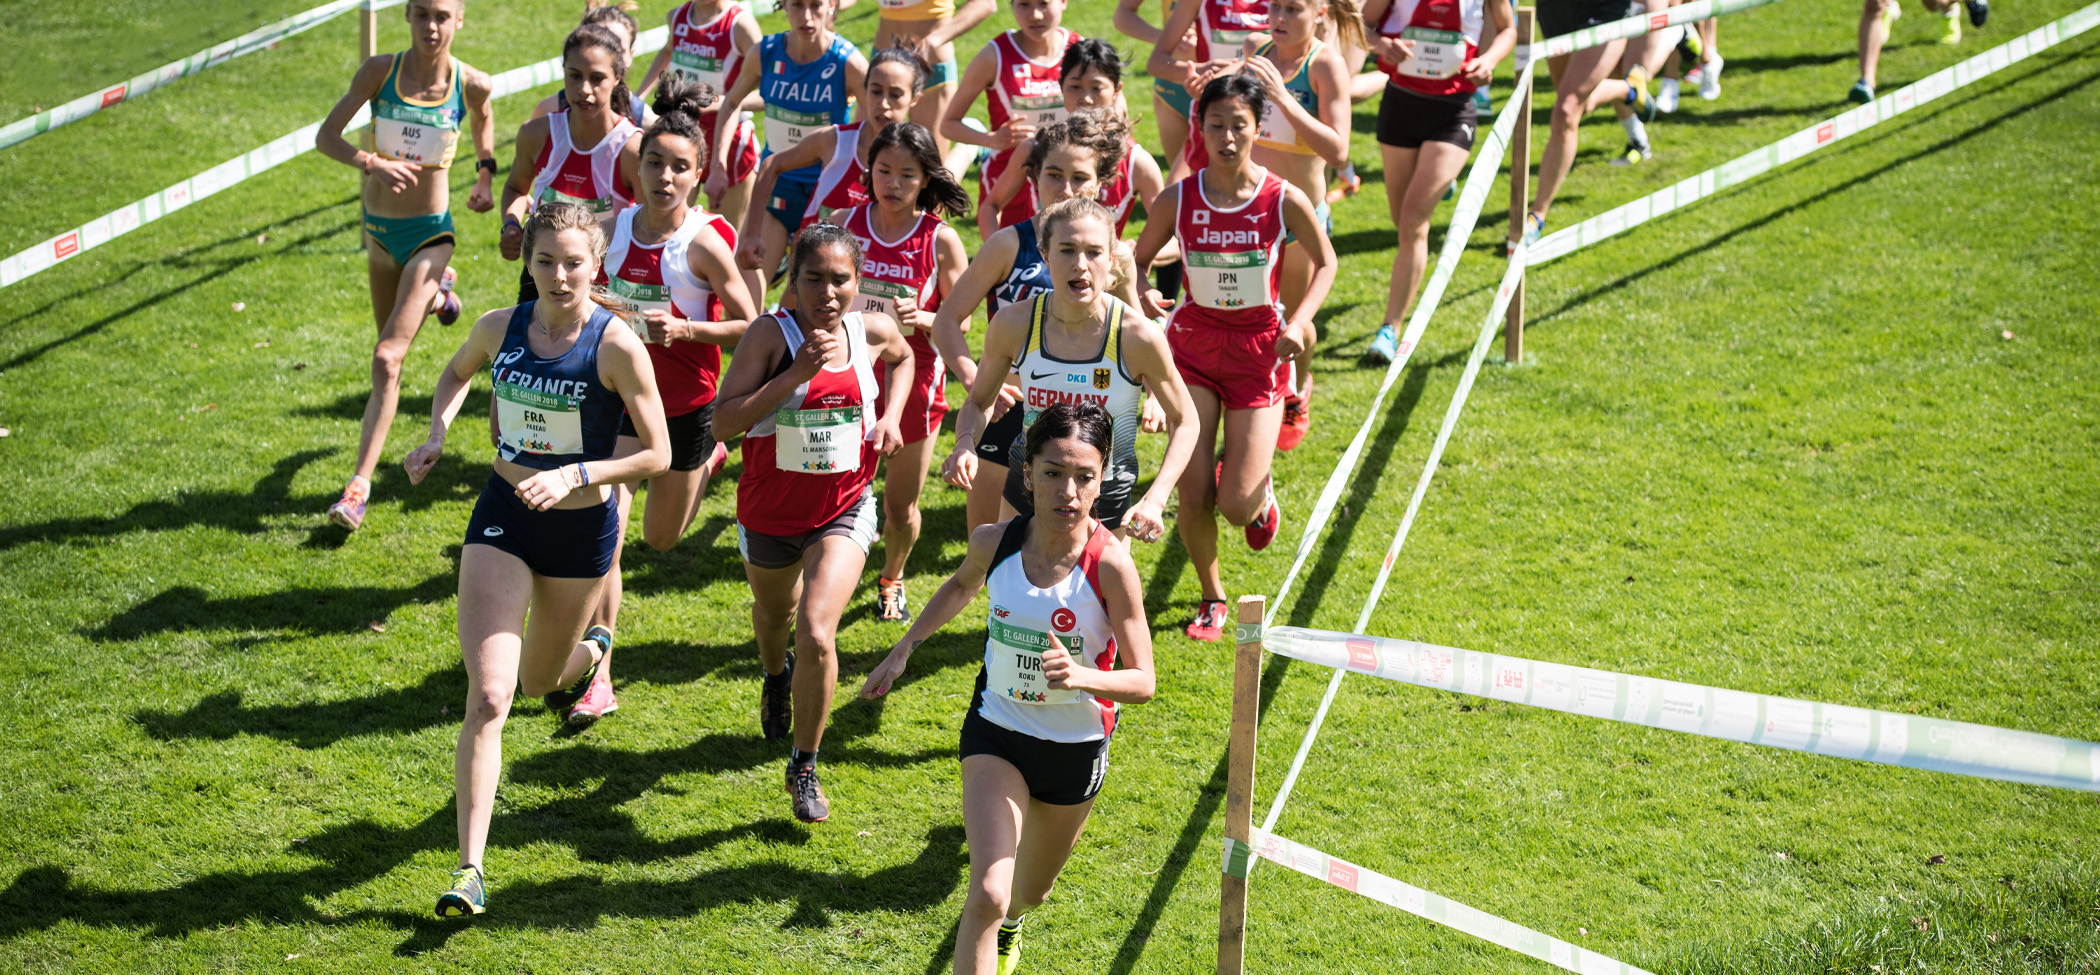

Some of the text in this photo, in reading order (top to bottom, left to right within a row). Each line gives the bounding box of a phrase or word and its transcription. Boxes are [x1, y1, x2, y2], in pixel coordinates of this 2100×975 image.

[770, 80, 832, 103] ITALIA
[1020, 79, 1062, 97] Japa
[402, 126, 421, 139] AUS
[788, 127, 802, 138] ITA
[1196, 227, 1260, 248] Japan
[1218, 273, 1237, 284] JPN
[637, 287, 652, 296] 2018
[863, 281, 900, 295] GALLEN 2018
[864, 299, 885, 312] JPN
[1067, 373, 1087, 383] DKB
[507, 370, 588, 400] FRANCE
[511, 388, 520, 398] ST.
[520, 391, 541, 404] GALLEN
[542, 396, 558, 406] 2018
[524, 410, 546, 424] FRA
[795, 414, 804, 422] ST.
[805, 412, 829, 421] GALLEN
[526, 423, 547, 432] PAREAU
[809, 431, 832, 443] MAR
[994, 606, 1010, 618] TAF
[1003, 629, 1012, 639] ST.
[1013, 632, 1040, 645] GALLEN
[1016, 653, 1041, 671] TUR
[1018, 672, 1036, 681] KOKU
